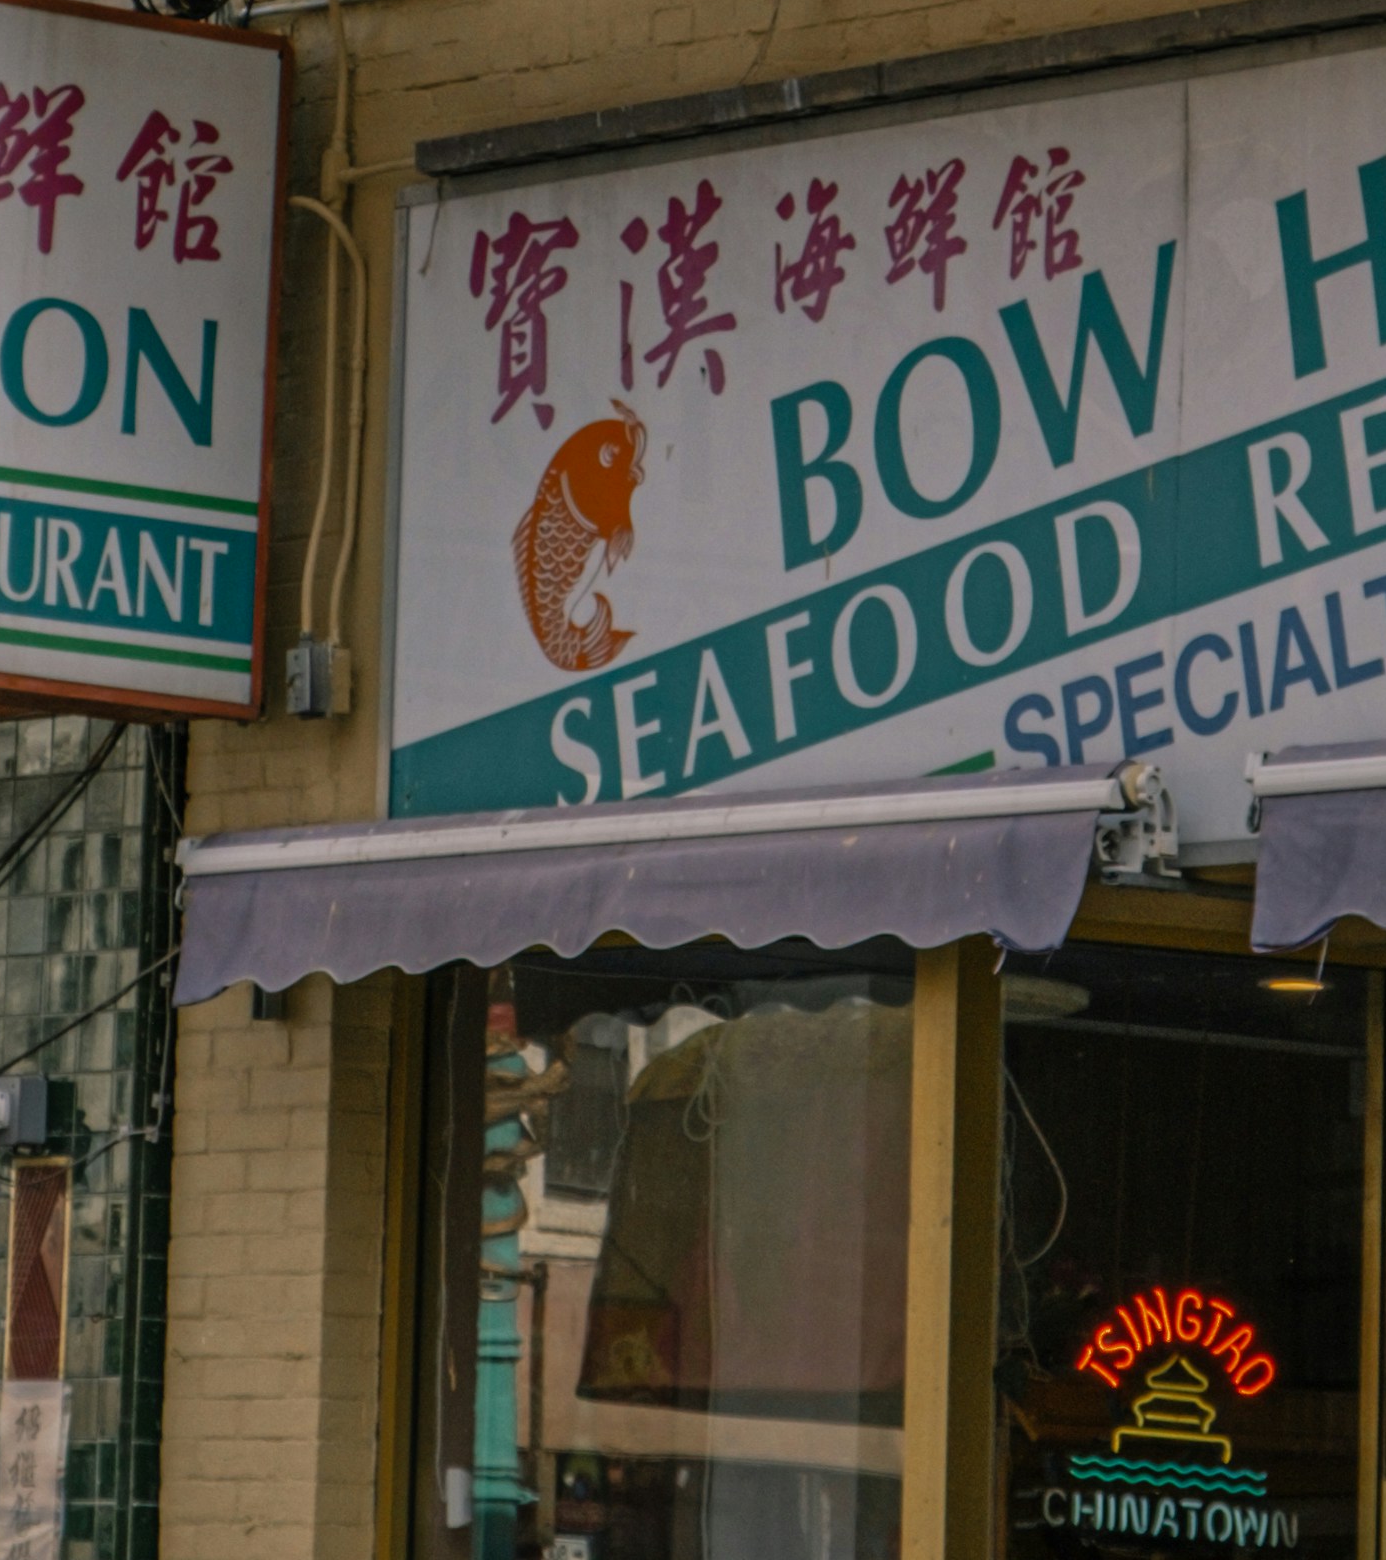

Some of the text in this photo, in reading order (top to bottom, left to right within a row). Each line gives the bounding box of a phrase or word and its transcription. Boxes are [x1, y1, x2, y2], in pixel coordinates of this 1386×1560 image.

[469, 145, 1087, 432] 寶漢海鮮館
[770, 240, 1177, 573] BOW
[549, 499, 1142, 808] SEAFOOD
[1074, 1286, 1276, 1397] TSINGTAO
[1043, 1488, 1299, 1549] CHINATOWN
